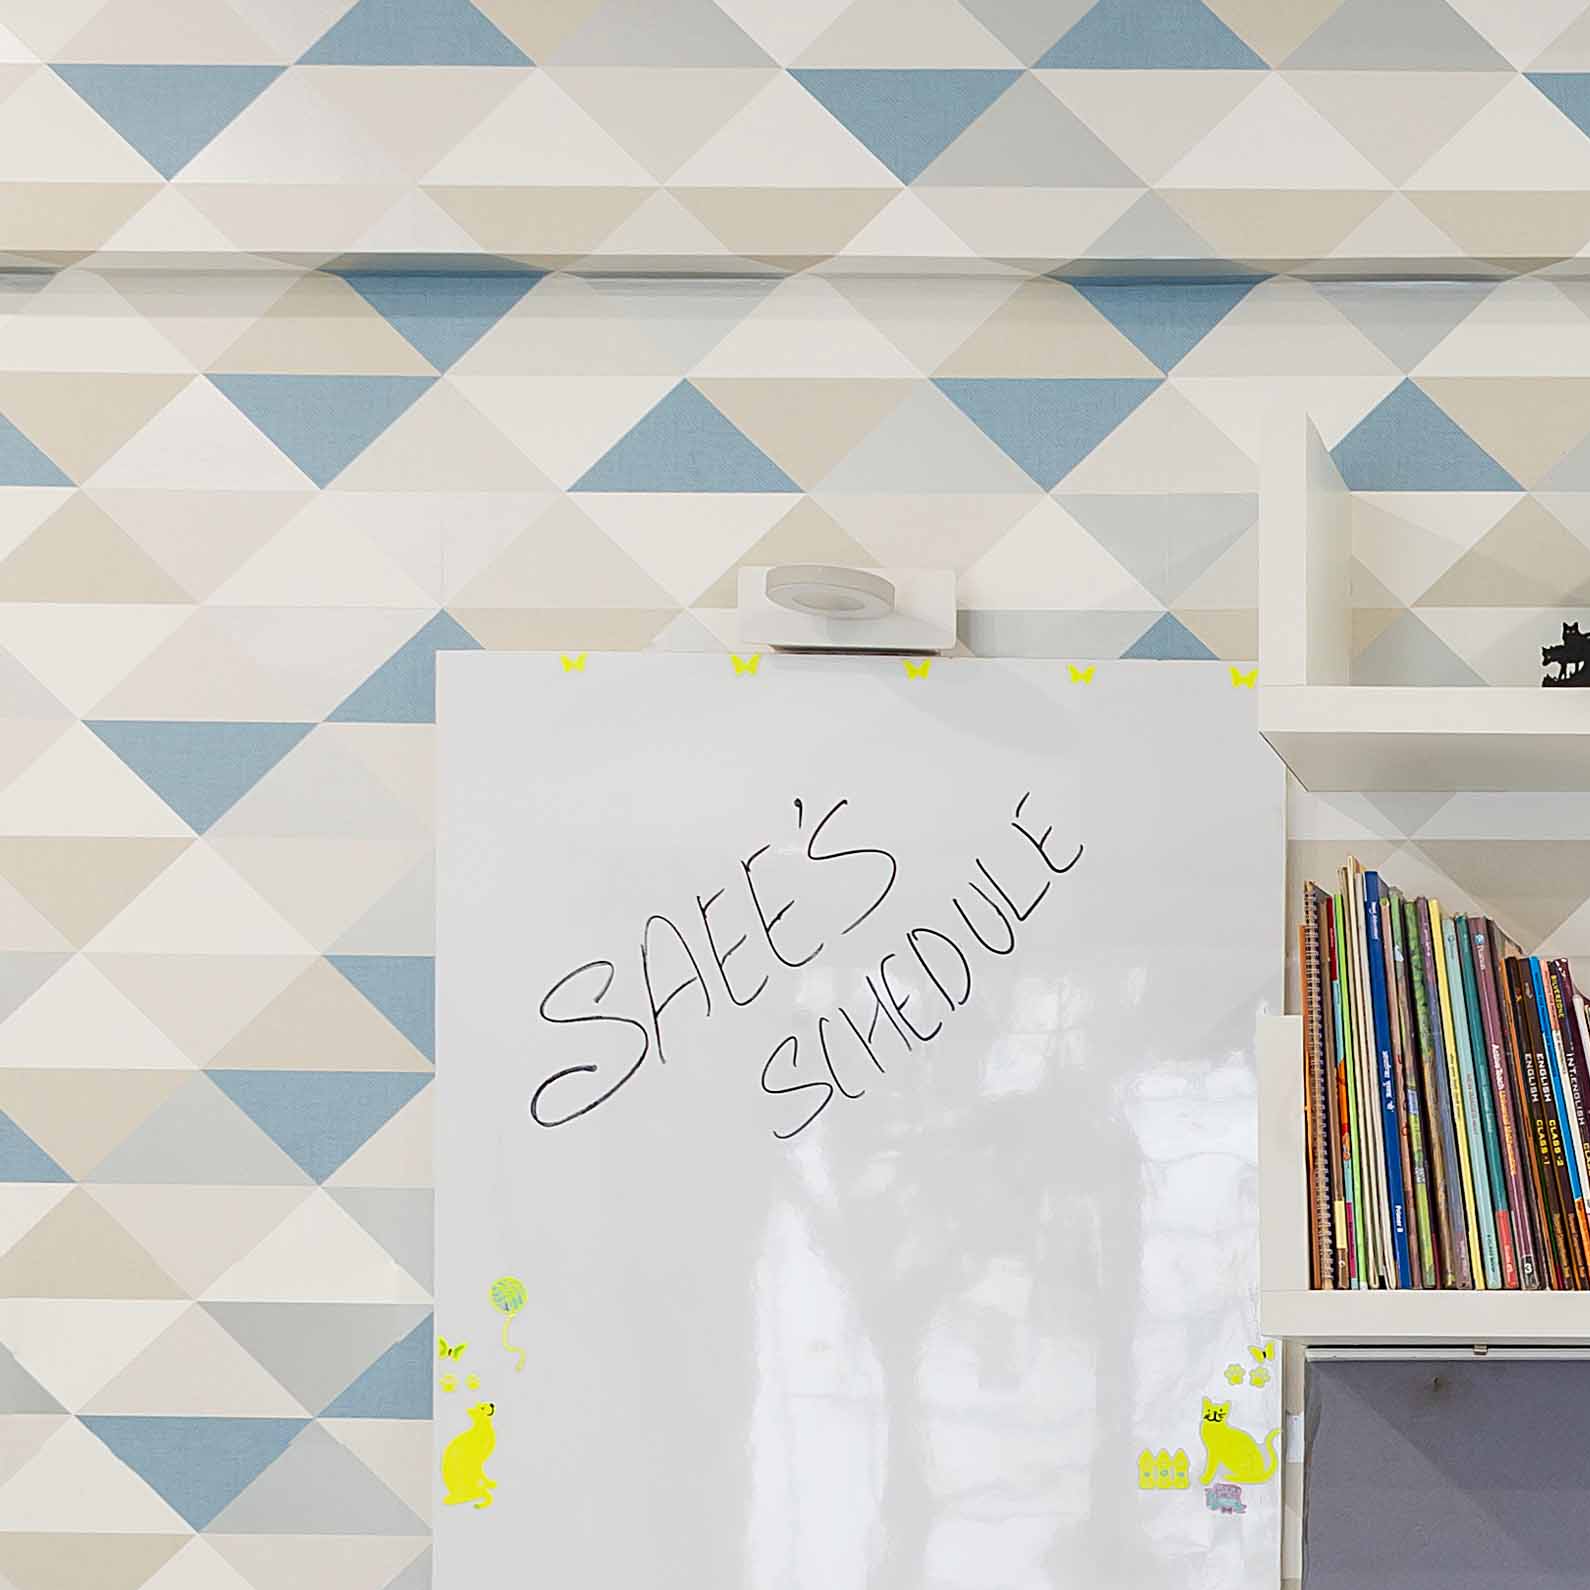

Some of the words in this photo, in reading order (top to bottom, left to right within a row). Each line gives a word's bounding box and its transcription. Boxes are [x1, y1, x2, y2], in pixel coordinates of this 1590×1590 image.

[760, 791, 1084, 1139] SCHEDULE
[1524, 1053, 1539, 1102] ENGLISH
[1536, 1119, 1547, 1152] CLASS
[1536, 1053, 1551, 1102] ENGLISH
[1548, 1119, 1560, 1152] CLASS
[1524, 1263, 1532, 1274] 3
